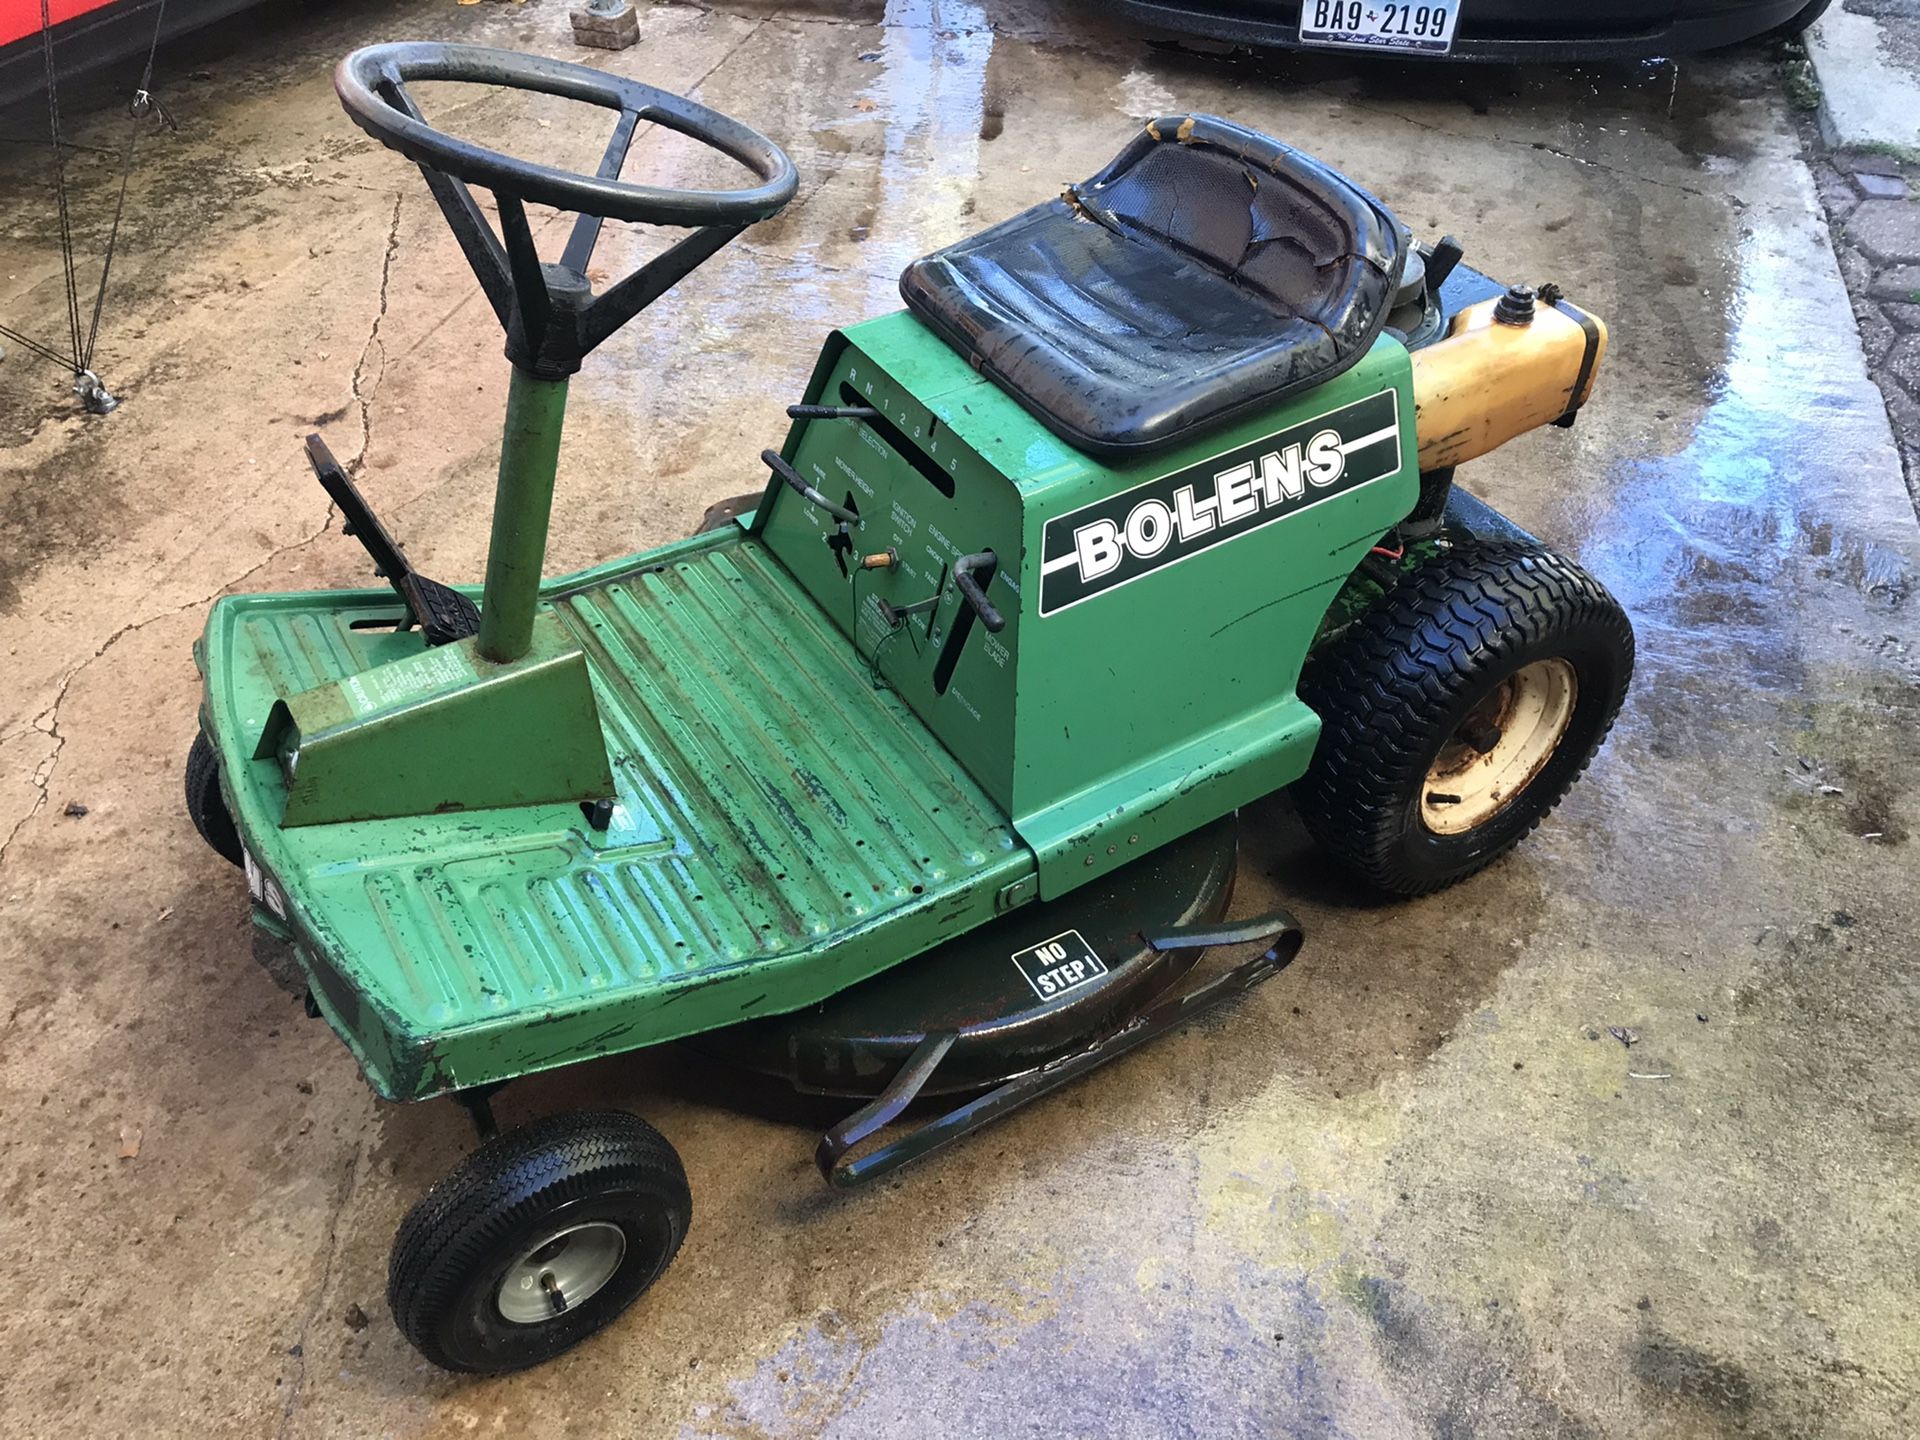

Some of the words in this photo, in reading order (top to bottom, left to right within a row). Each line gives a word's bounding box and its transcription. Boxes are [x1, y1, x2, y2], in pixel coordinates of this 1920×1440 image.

[1314, 0, 1362, 31] BA9
[1380, 3, 1447, 38] 2199
[1347, 33, 1367, 43] Lone
[1368, 35, 1387, 45] Star
[849, 367, 857, 382] R
[865, 382, 874, 396] N
[884, 398, 889, 410] 1
[899, 412, 906, 425] 2
[914, 425, 921, 438] 3
[930, 441, 937, 453] 4
[950, 458, 957, 471] 5
[858, 426, 888, 460] SELECTION
[1074, 428, 1346, 584] BOLENS
[821, 531, 828, 543] 2
[859, 519, 866, 532] 5
[928, 523, 952, 551] ENGINE
[983, 641, 1007, 669] BLADE
[984, 630, 1010, 661] MOWER
[1034, 942, 1067, 966] NO
